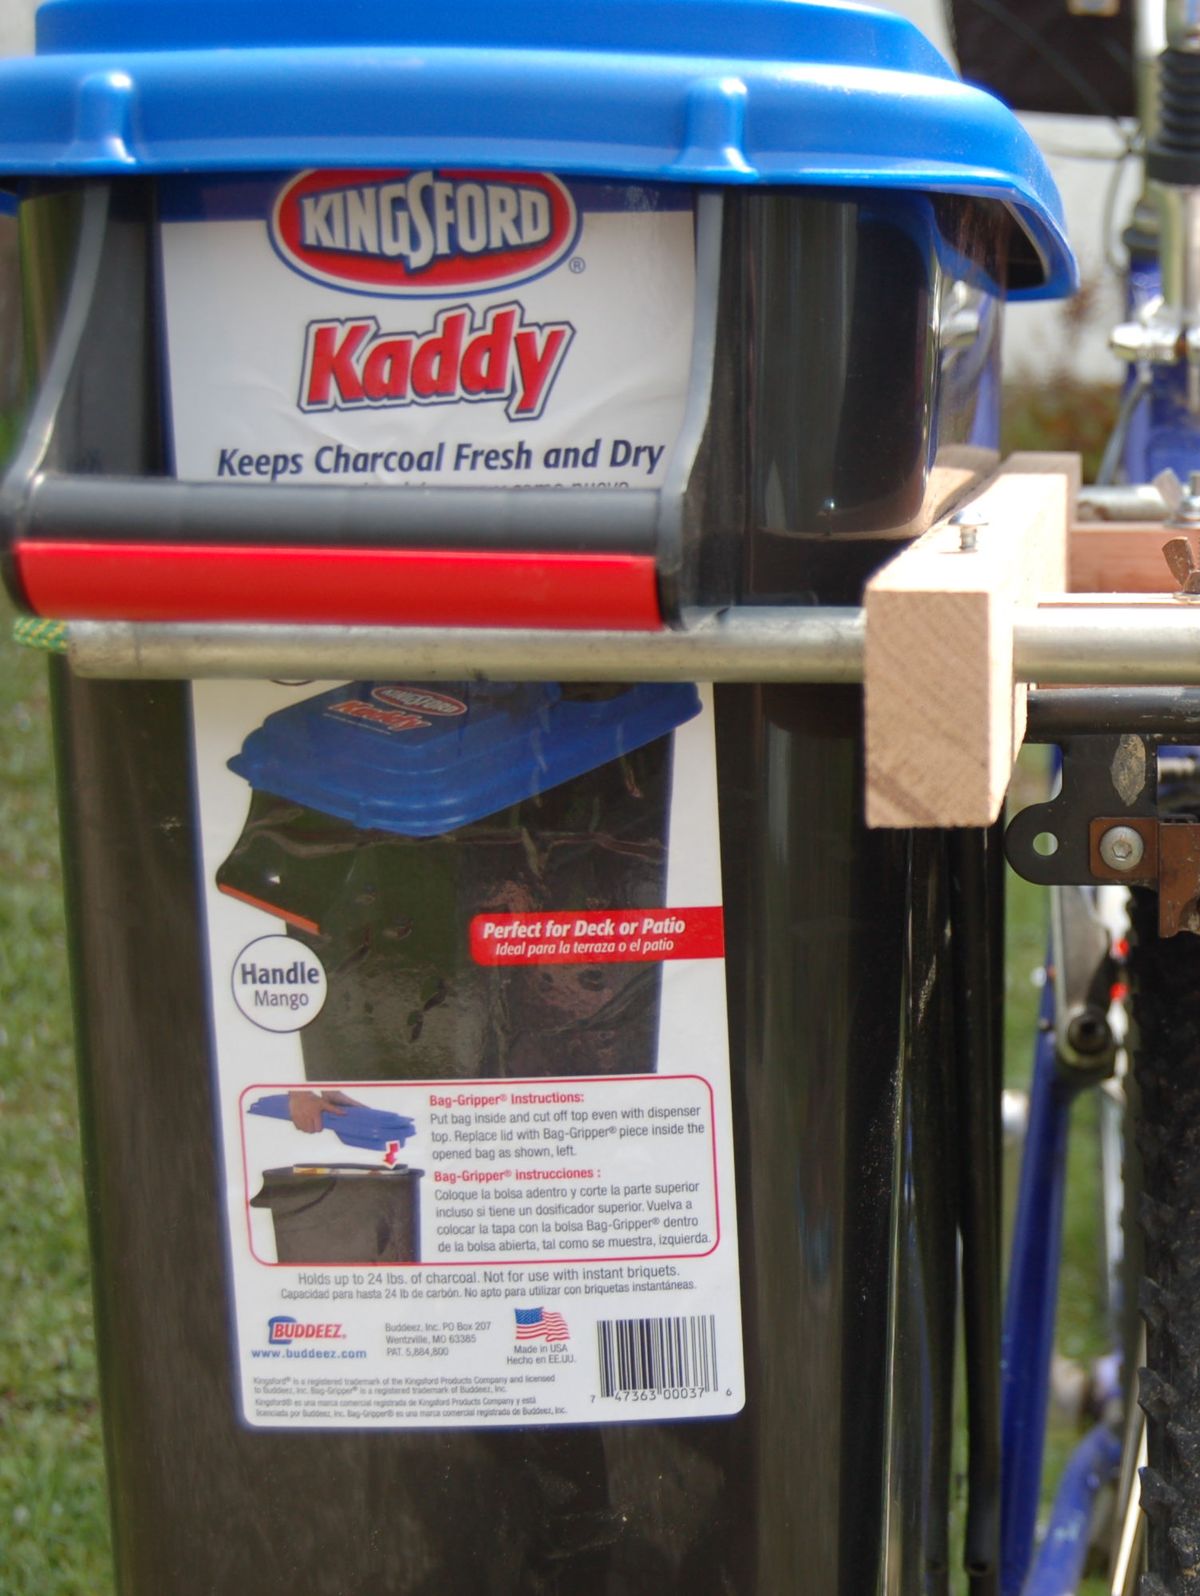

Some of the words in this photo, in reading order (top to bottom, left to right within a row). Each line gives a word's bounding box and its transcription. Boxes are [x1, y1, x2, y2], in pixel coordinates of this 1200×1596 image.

[304, 171, 550, 270] KINGSFORD
[302, 303, 574, 419] Kaddy
[217, 447, 303, 482] Keeps
[314, 442, 444, 473] Charcoal
[453, 440, 532, 470] Fresh
[542, 439, 601, 468] and
[609, 438, 664, 475] Dry
[483, 920, 541, 938] Perfect
[544, 920, 570, 937] for
[572, 918, 614, 936] Deck
[617, 921, 640, 935] or
[640, 917, 684, 934] Patio
[495, 942, 525, 955] Ideal
[526, 944, 556, 957] para
[557, 941, 570, 954] la
[572, 940, 615, 953] terraza
[618, 942, 626, 952] o
[628, 940, 640, 952] el
[642, 939, 673, 954] patio
[241, 961, 320, 984] Handle
[254, 990, 309, 1010] Mango
[251, 1348, 367, 1359] www.buddeez.com
[514, 1345, 537, 1353] Made
[550, 1344, 567, 1353] USA
[614, 1389, 657, 1402] 47363
[663, 1387, 705, 1400] 00037
[725, 1388, 732, 1396] 6
